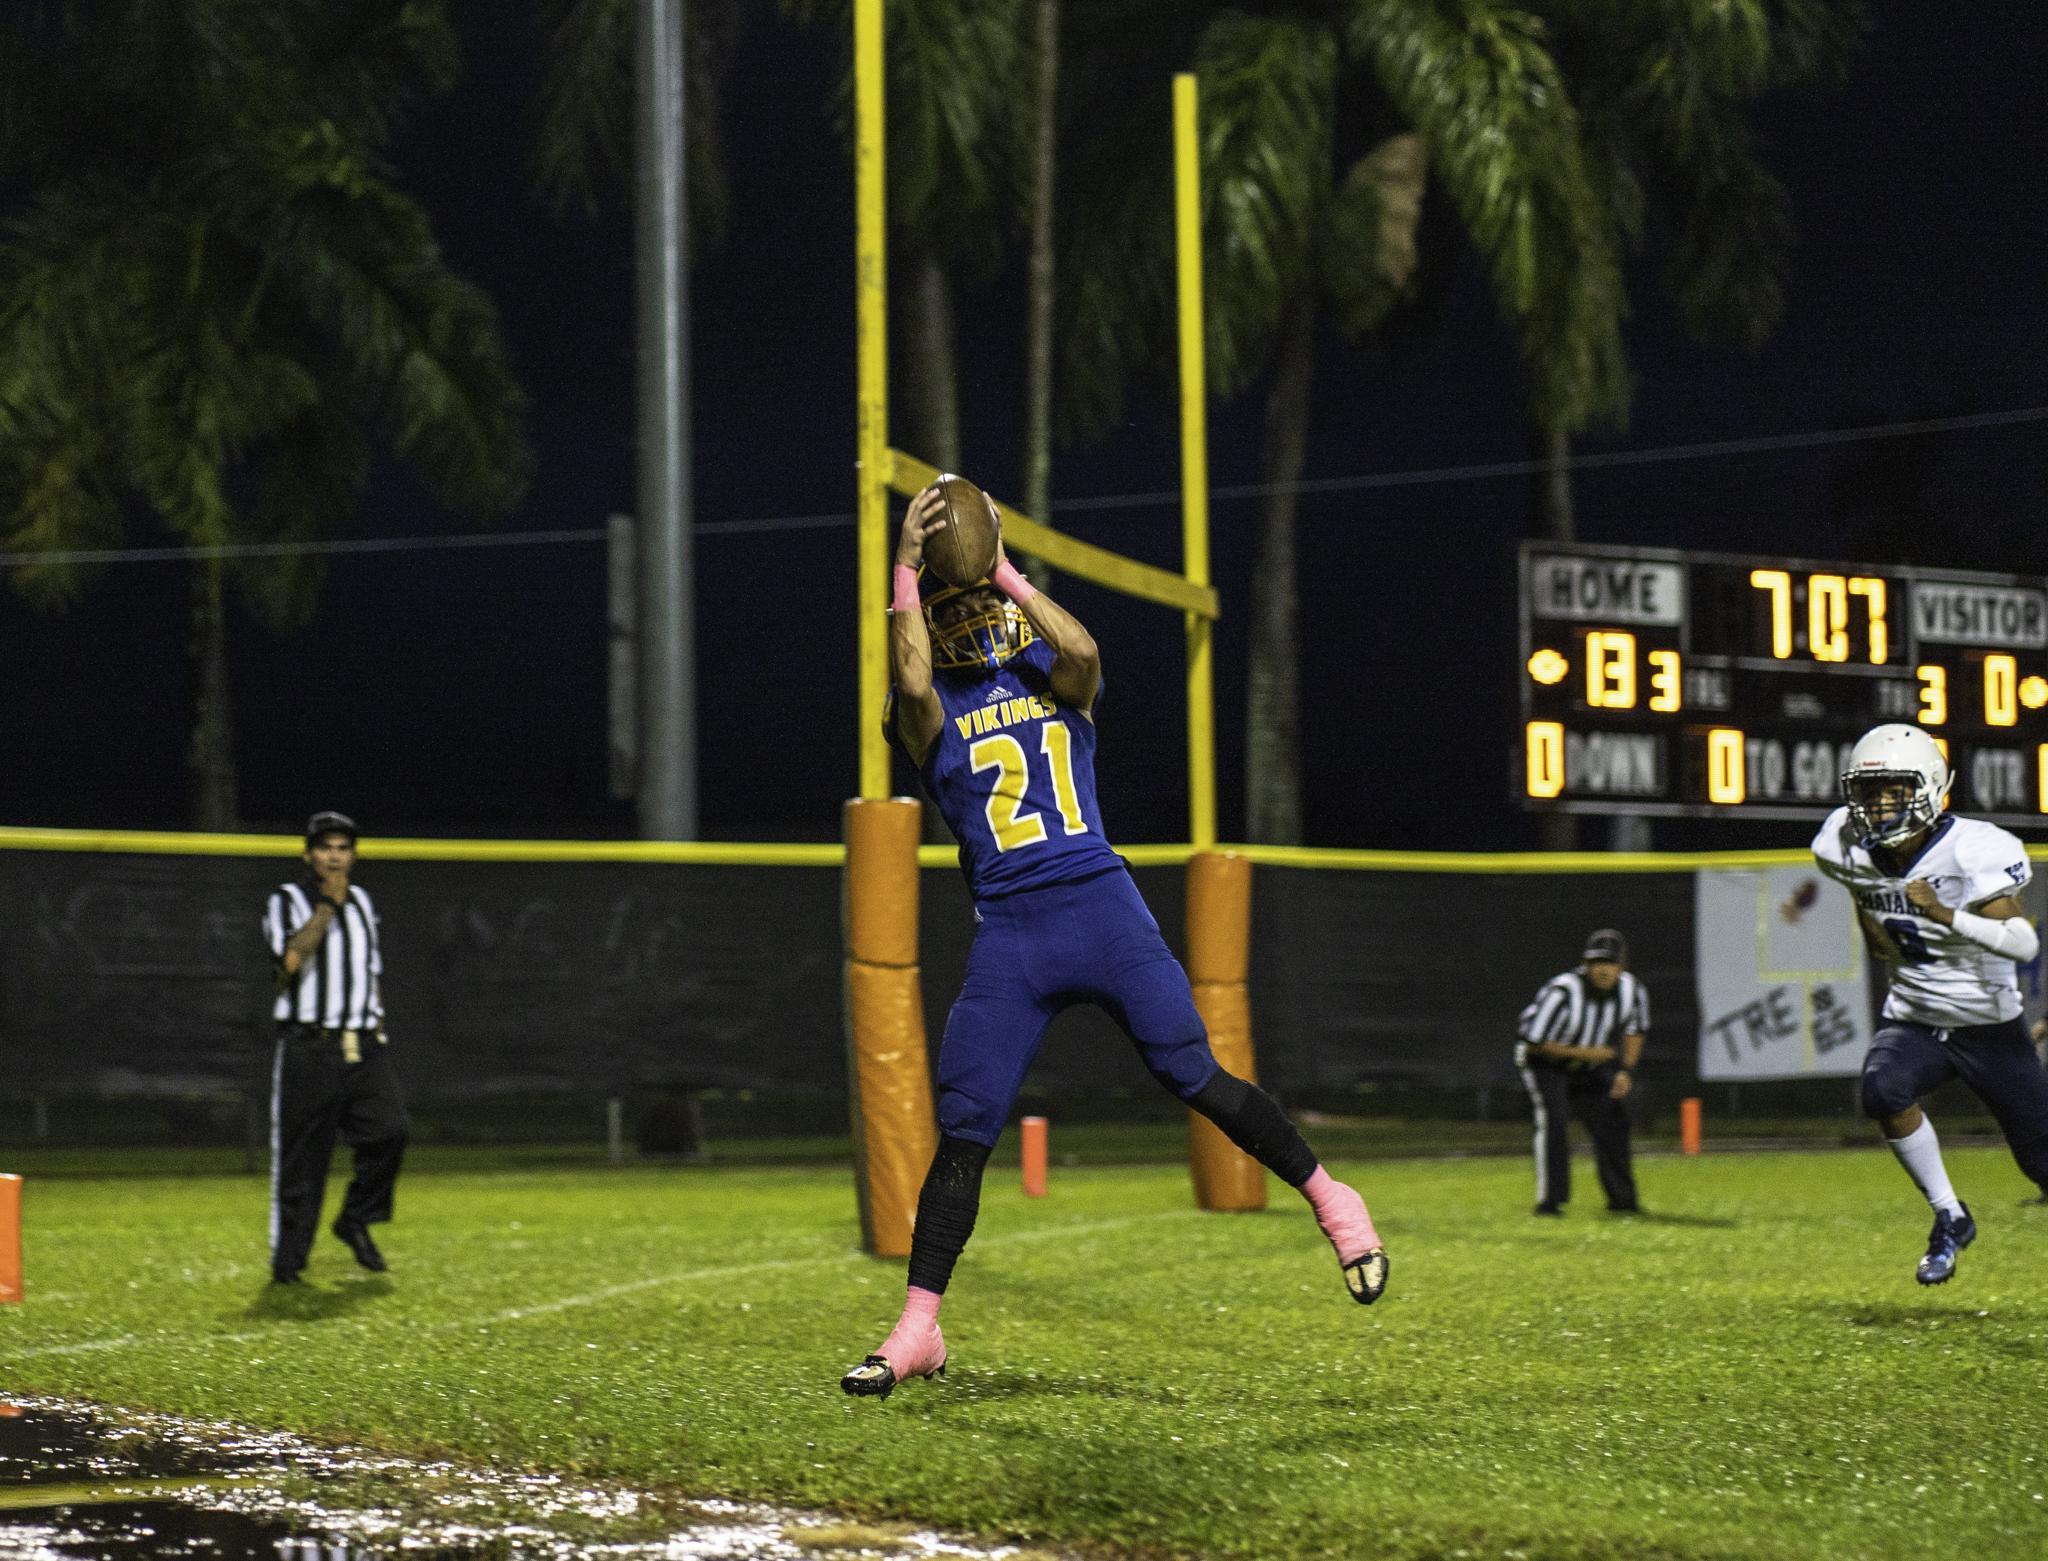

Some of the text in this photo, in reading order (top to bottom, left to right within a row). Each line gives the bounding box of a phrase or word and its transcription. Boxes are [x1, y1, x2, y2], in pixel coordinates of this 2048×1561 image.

[1551, 567, 1659, 613] HOME
[1919, 595, 2041, 642] VISITOR
[1648, 651, 1682, 712] 3
[1916, 665, 1947, 724] 3
[1983, 654, 2018, 726] 0
[955, 691, 1057, 740] VIKINGS
[969, 720, 1088, 853] 21
[1526, 721, 1565, 798] 0
[1708, 729, 1746, 804] 0
